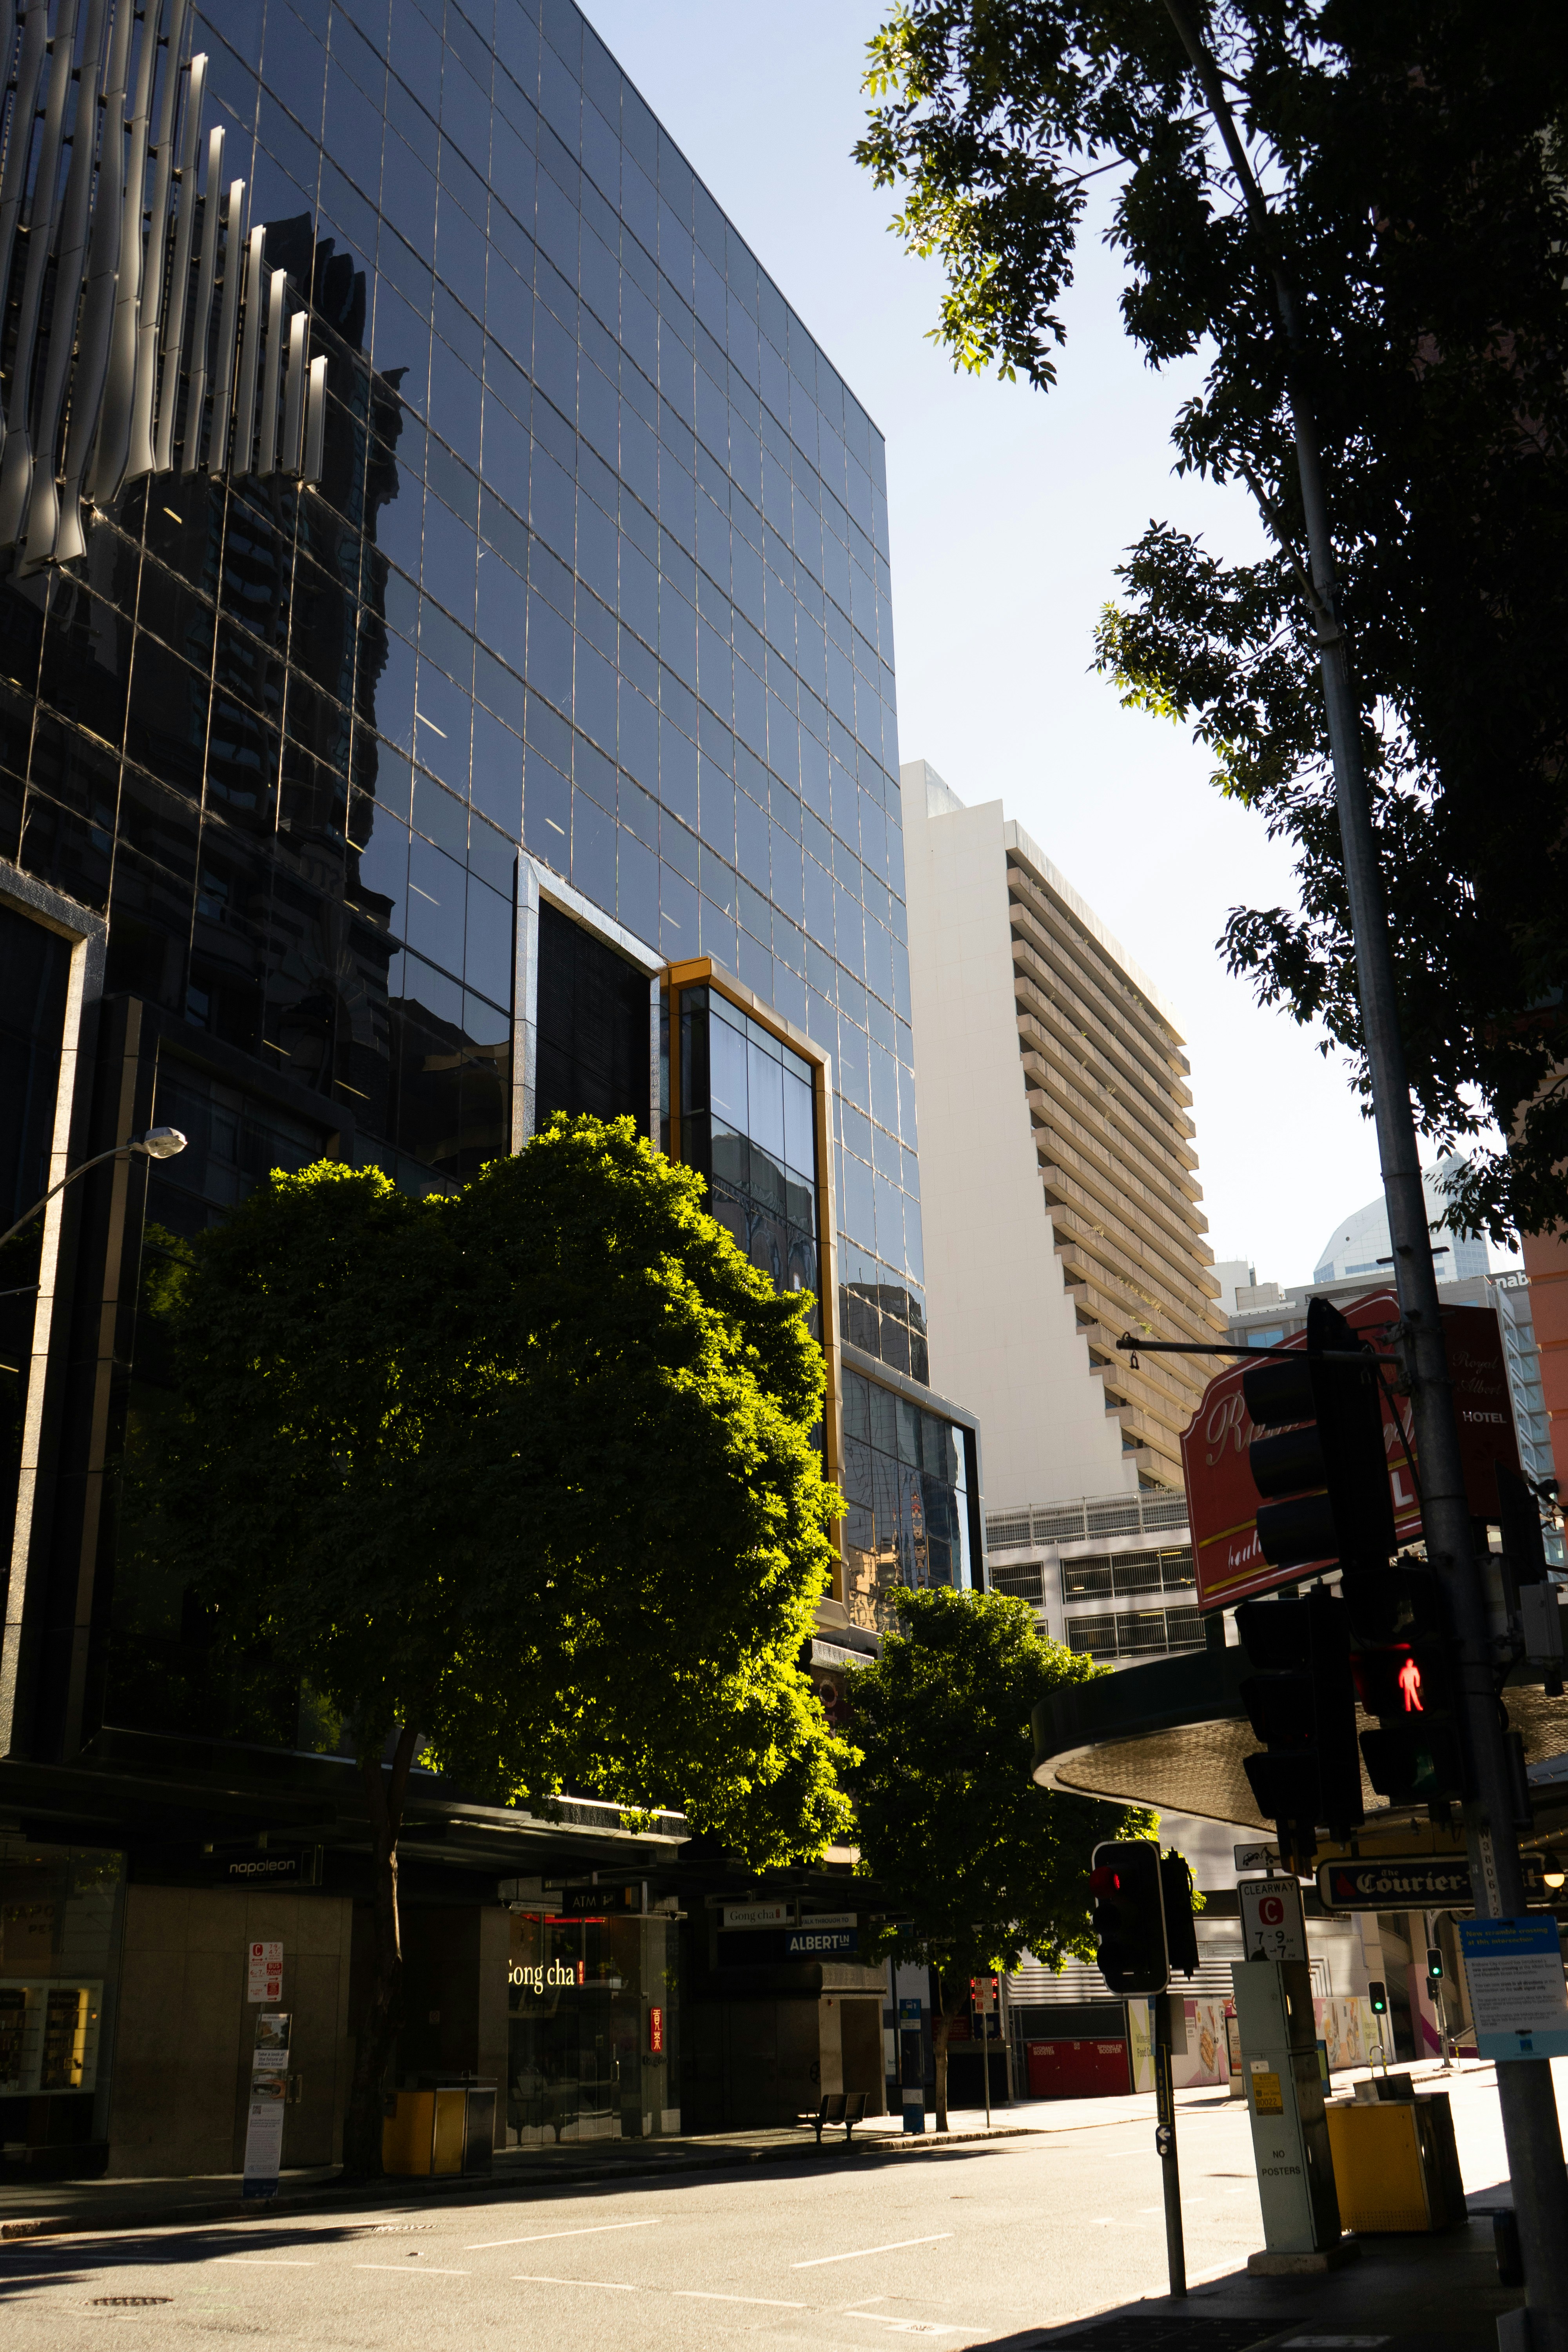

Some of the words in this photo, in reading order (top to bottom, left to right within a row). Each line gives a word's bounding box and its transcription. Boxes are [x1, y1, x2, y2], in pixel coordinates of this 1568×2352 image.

[1495, 1272, 1529, 1289] nab
[1453, 1351, 1499, 1374] Royal
[1457, 1377, 1502, 1395] Albert
[1463, 1411, 1507, 1423] HOTEL
[229, 1859, 295, 1877] napoleon
[1244, 1882, 1294, 1896] CLEARWAY
[572, 1896, 596, 1908] ATM
[730, 1911, 756, 1923] Gong
[757, 1909, 774, 1919] cha
[1265, 1900, 1278, 1922] C
[790, 1935, 839, 1951] ALBERT
[839, 1935, 849, 1944] LN
[547, 1958, 575, 1985] cha
[1272, 2150, 1285, 2158] NO
[1261, 2166, 1301, 2176] POSTERS
